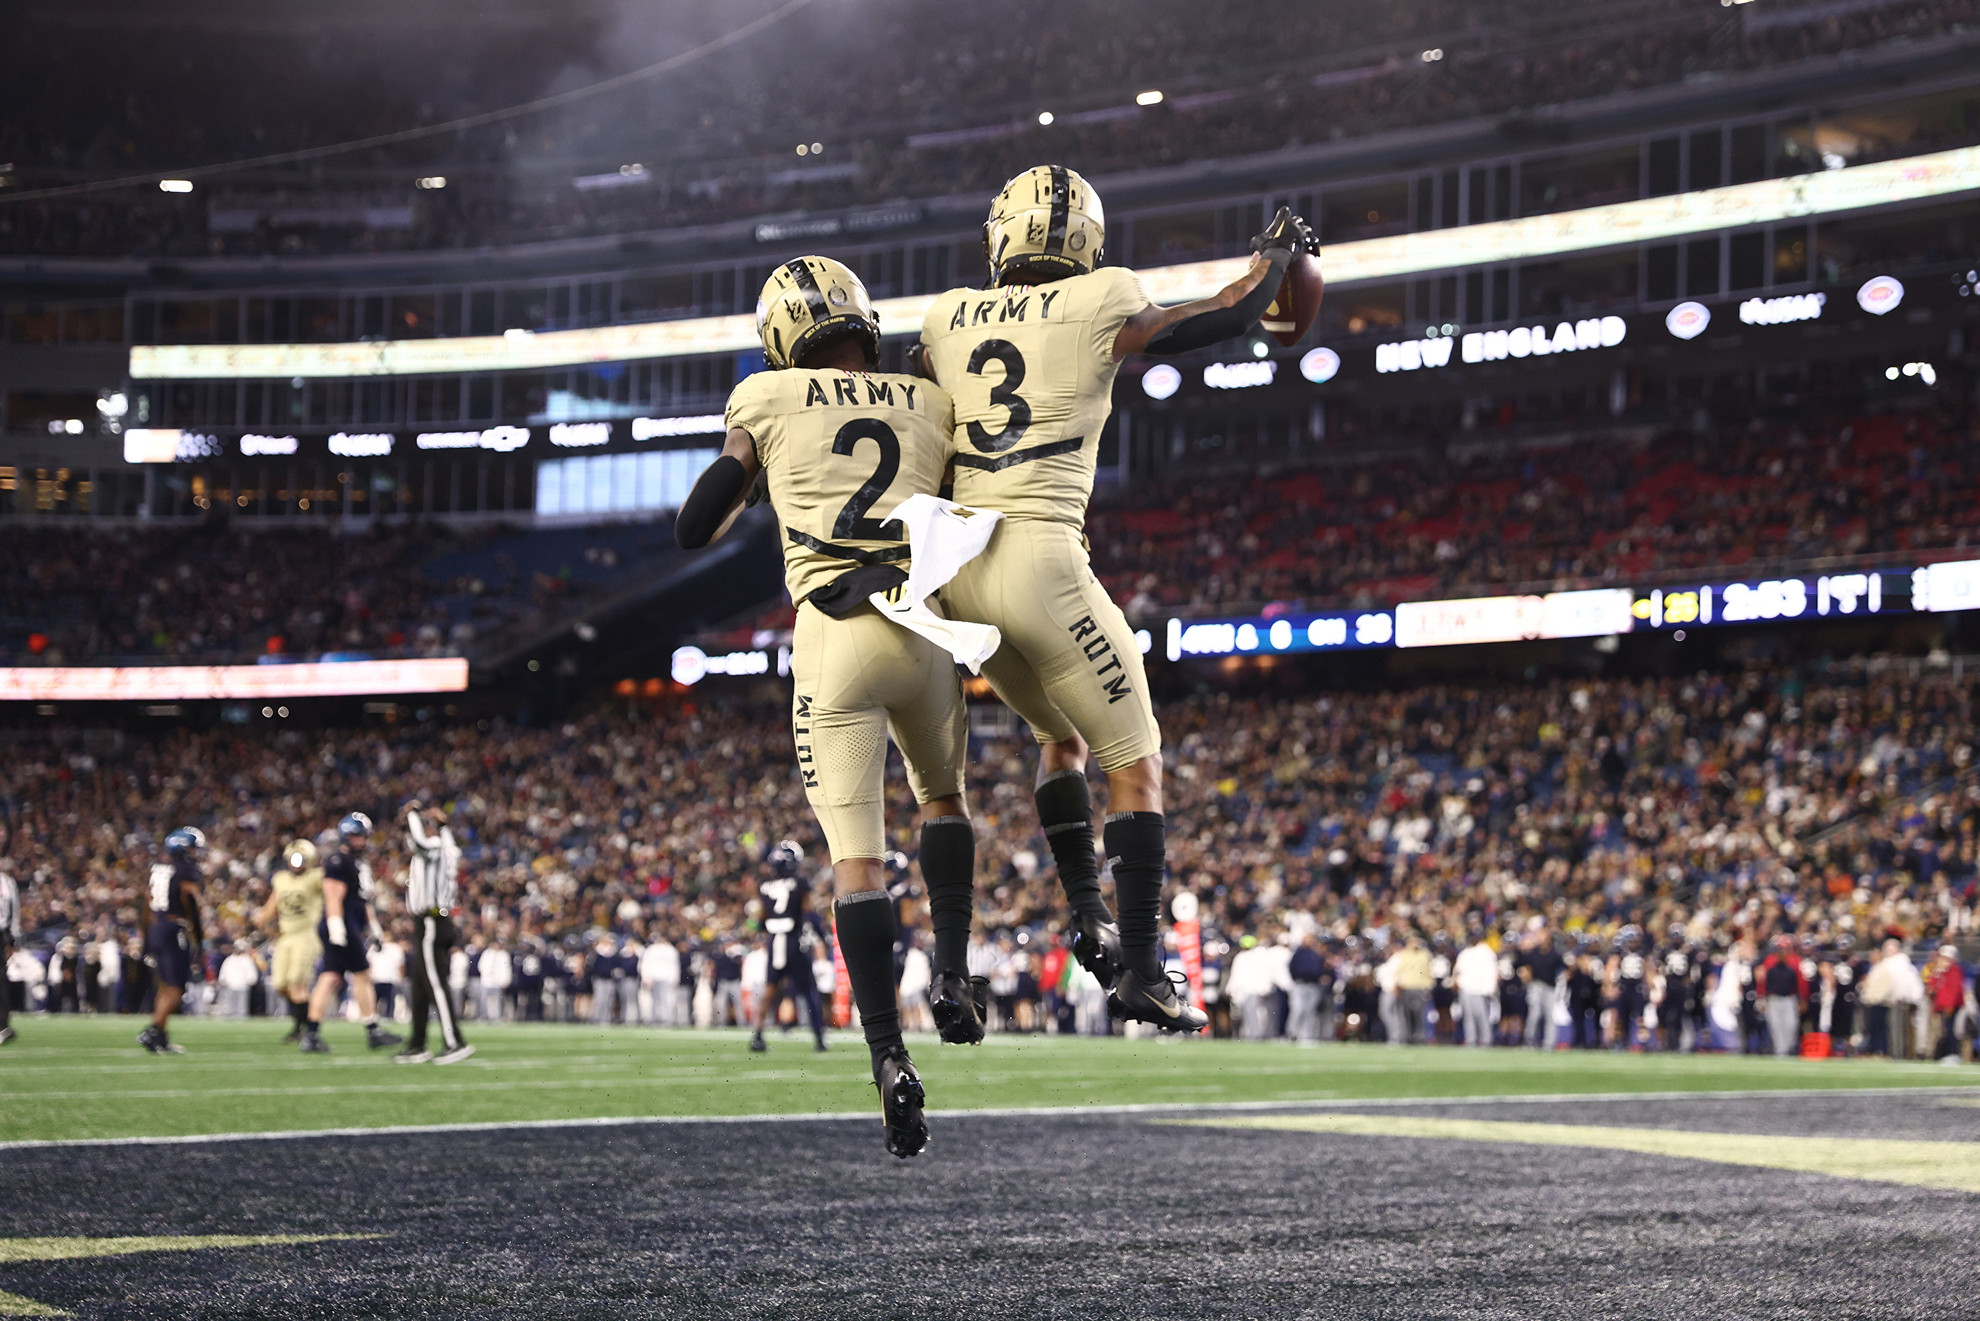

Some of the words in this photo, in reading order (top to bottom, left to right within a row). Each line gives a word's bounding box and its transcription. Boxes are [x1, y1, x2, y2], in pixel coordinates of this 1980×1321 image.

[804, 328, 816, 339] ROCK
[949, 289, 1060, 332] ARMY
[1376, 336, 1454, 374] NEW
[1462, 315, 1626, 364] ENGLAND
[805, 378, 916, 411] ARMY
[966, 338, 1032, 454] 3
[831, 417, 904, 541] 2
[1068, 615, 1132, 705] ROTM
[795, 694, 819, 788] ROTM
